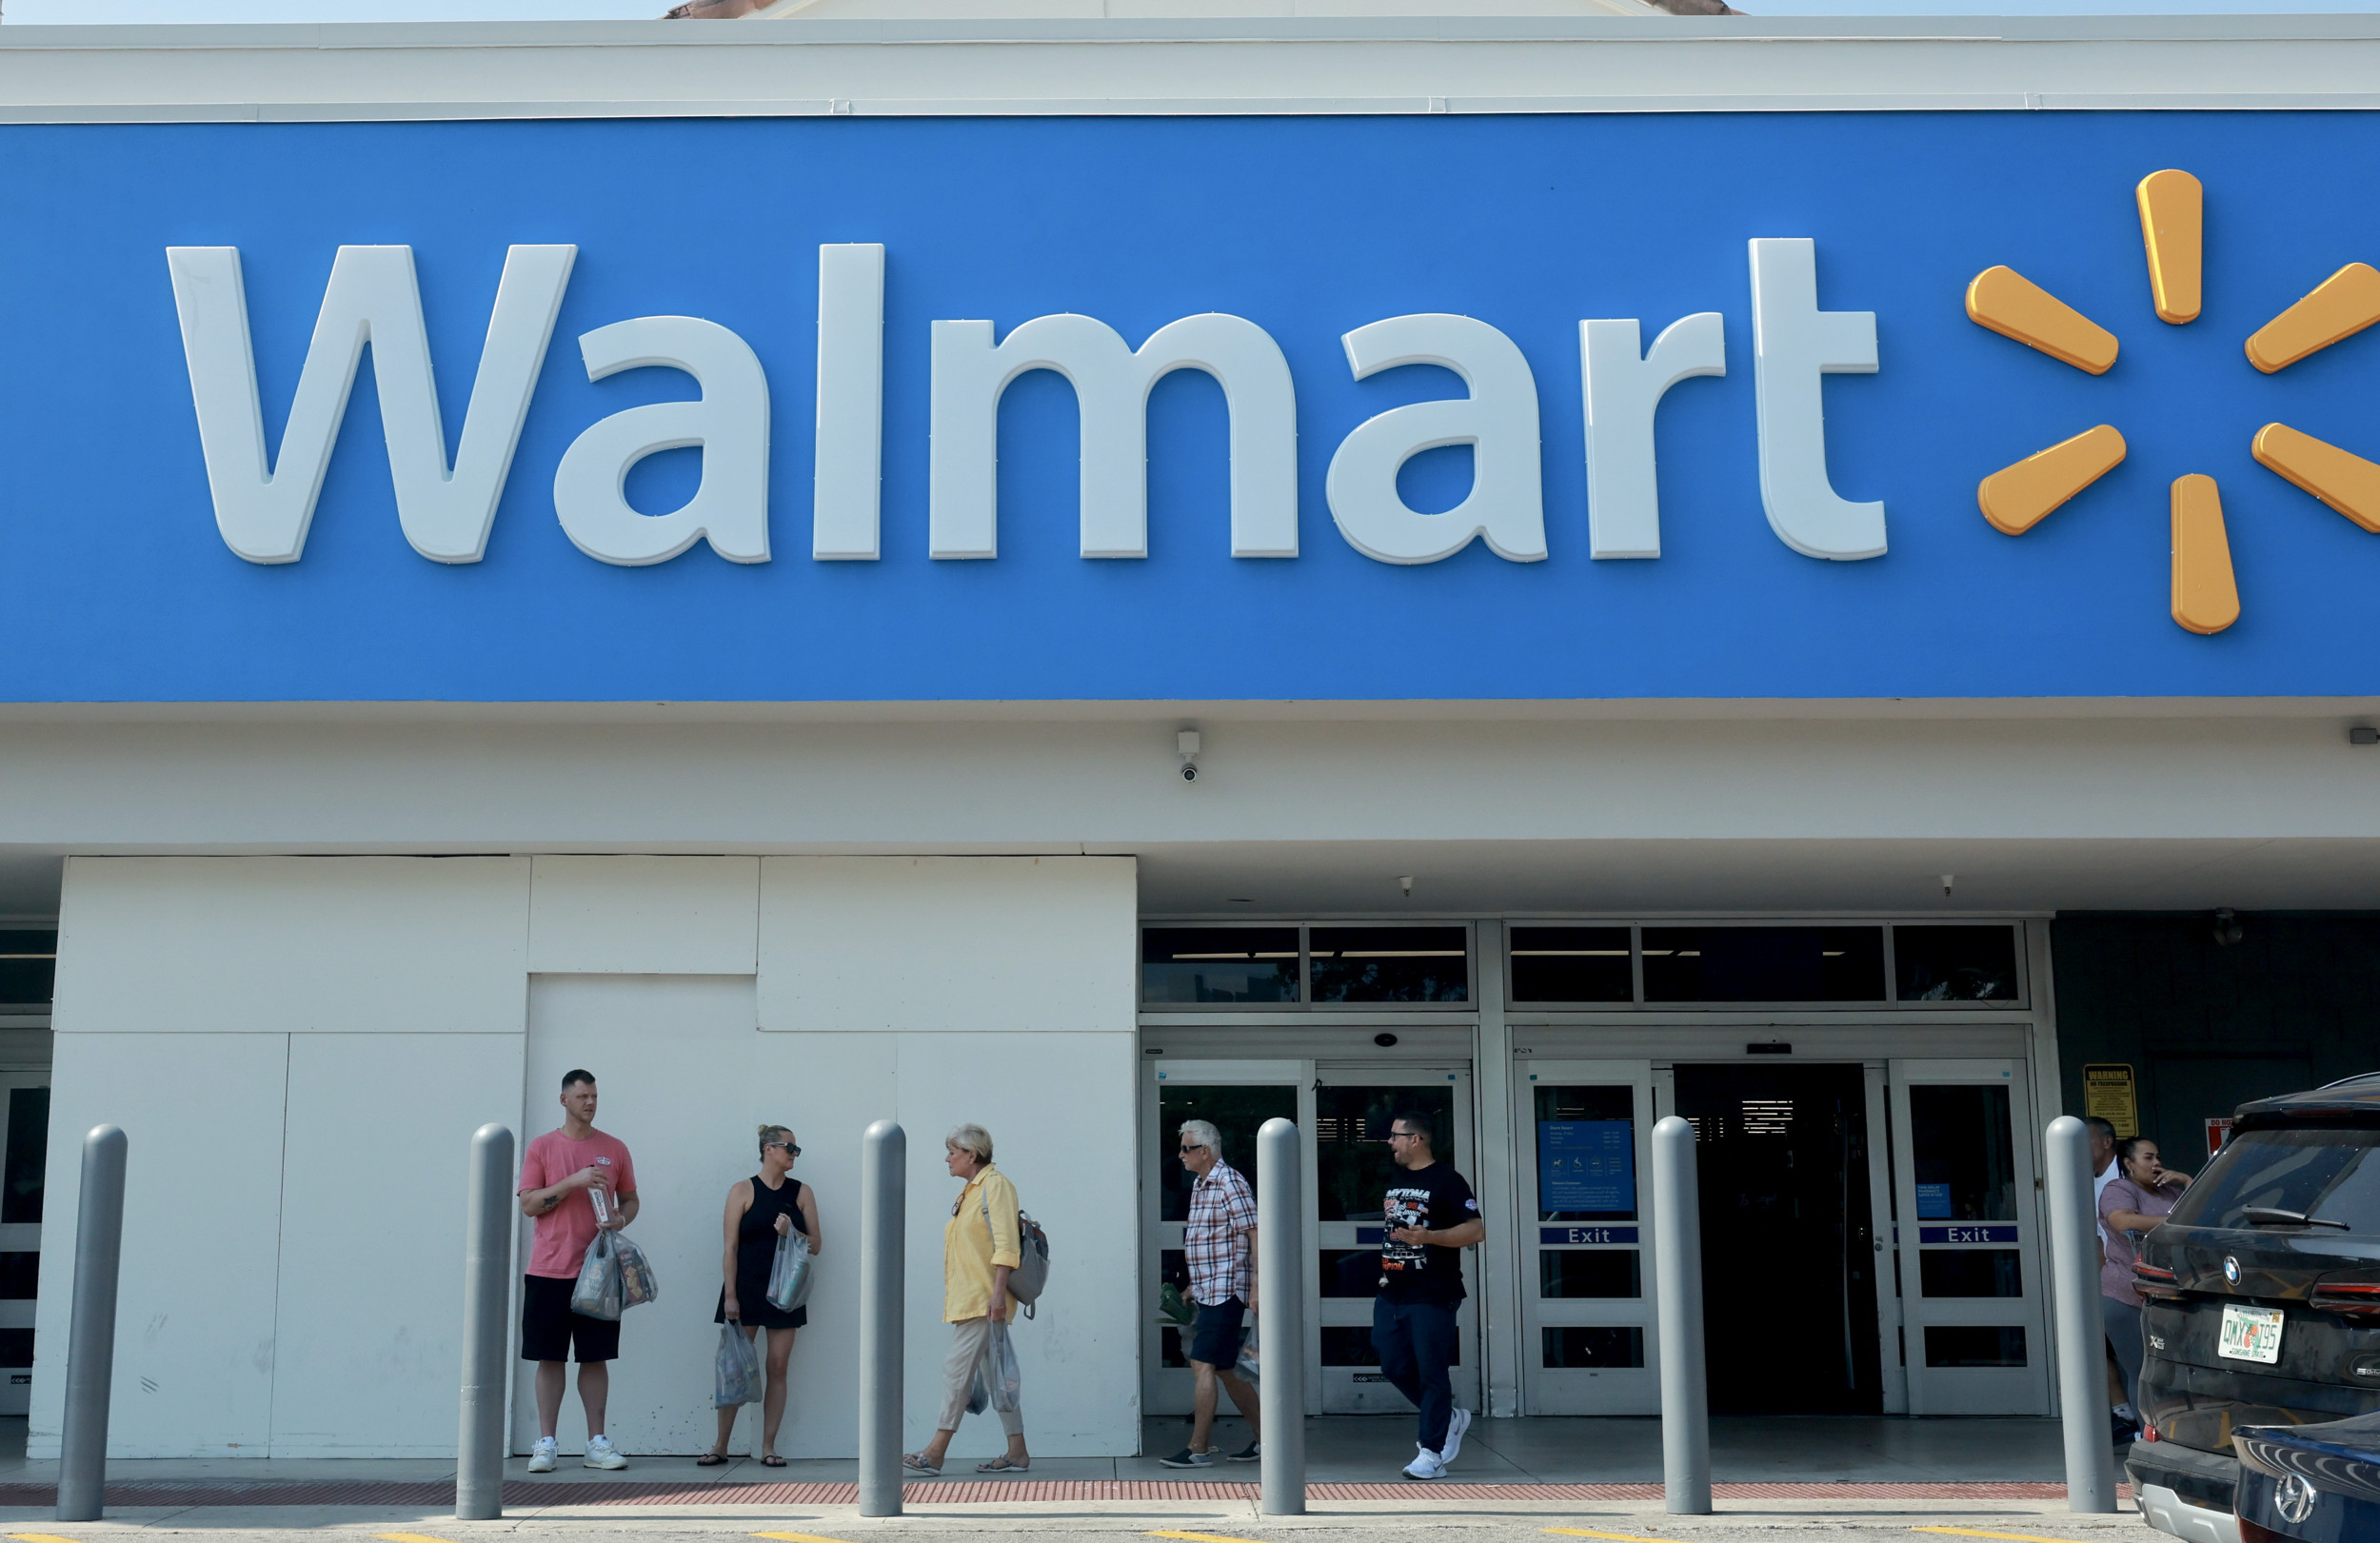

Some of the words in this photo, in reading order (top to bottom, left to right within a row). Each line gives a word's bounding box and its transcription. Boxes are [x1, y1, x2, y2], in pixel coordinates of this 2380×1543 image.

[165, 237, 1890, 565] Walmart
[2088, 1070, 2129, 1080] WARNING
[1569, 1228, 1611, 1243] Exit
[1948, 1227, 1990, 1242] Exit
[2224, 1319, 2246, 1347] QMX
